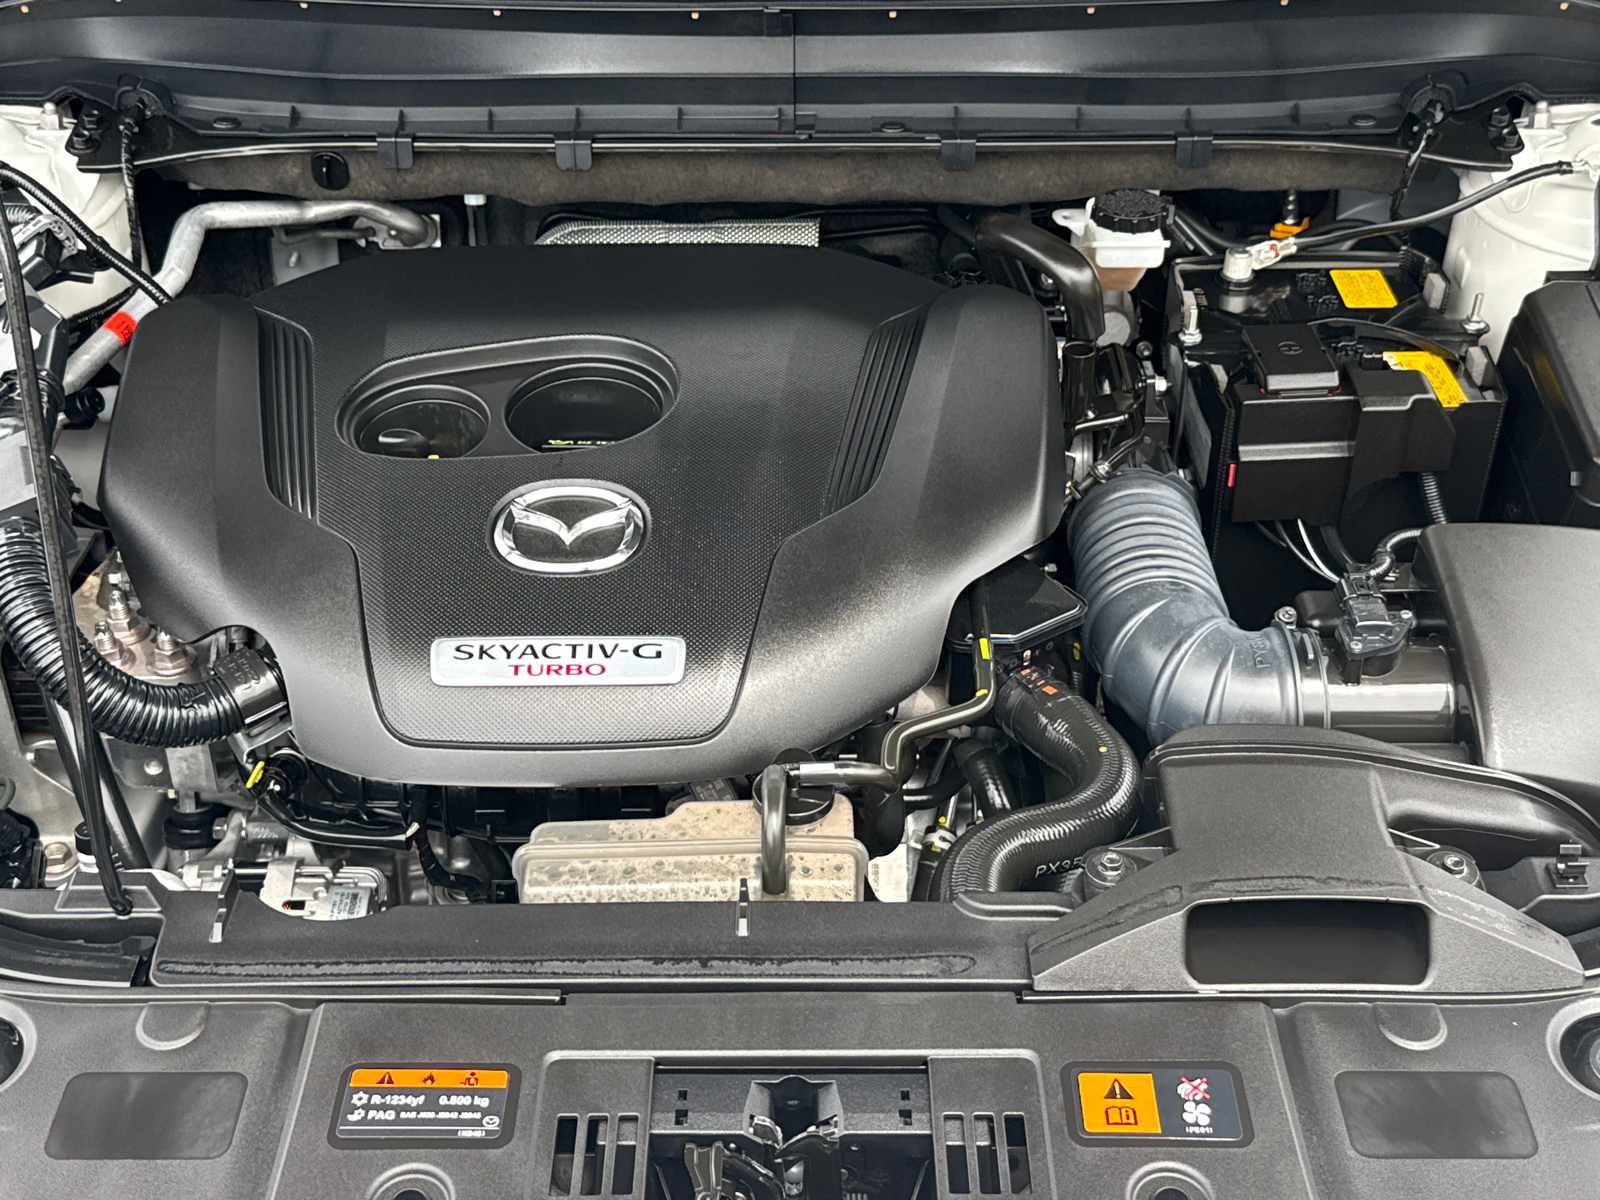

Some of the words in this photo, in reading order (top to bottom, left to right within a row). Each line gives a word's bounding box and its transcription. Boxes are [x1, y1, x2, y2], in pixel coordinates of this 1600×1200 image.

[452, 643, 663, 661] SKYACTIV-G
[507, 663, 607, 677] TURBO
[370, 1094, 426, 1107] R-1234yf
[438, 1095, 472, 1106] 0.500
[473, 1095, 490, 1108] kg
[367, 1109, 396, 1121] PAG
